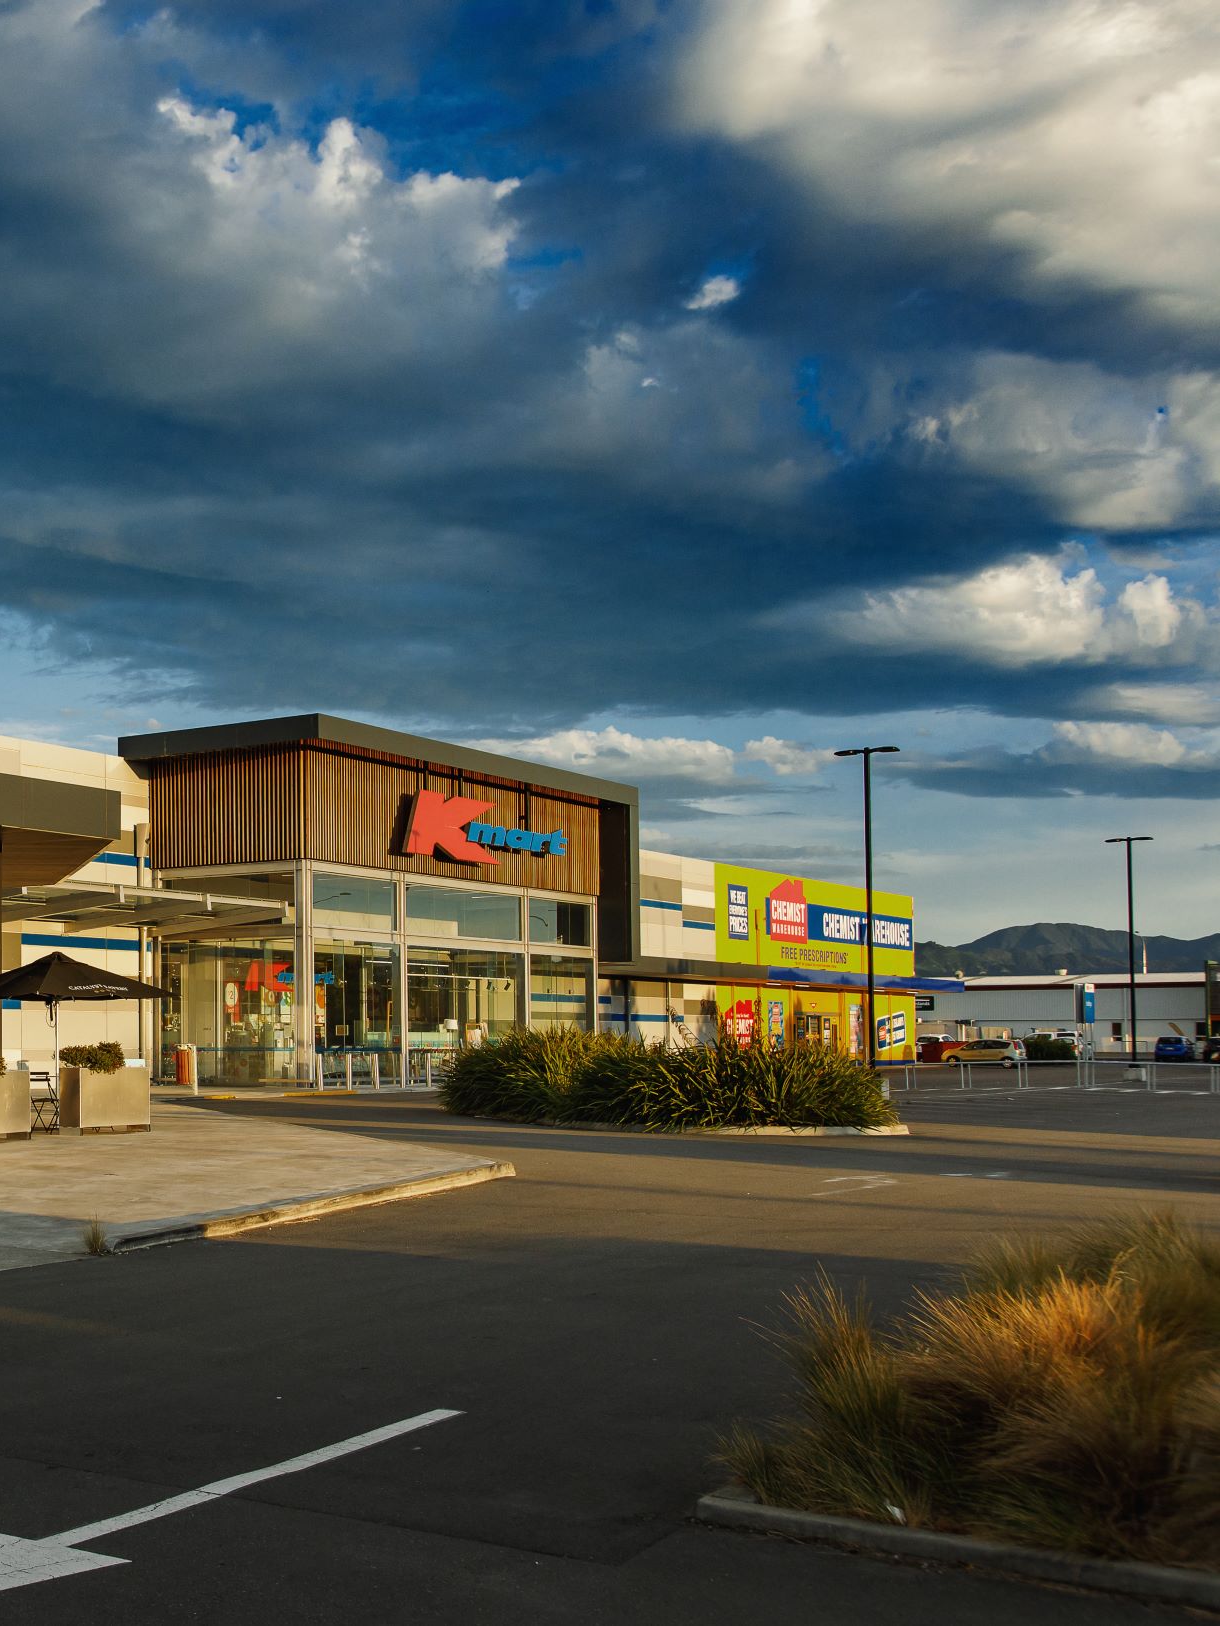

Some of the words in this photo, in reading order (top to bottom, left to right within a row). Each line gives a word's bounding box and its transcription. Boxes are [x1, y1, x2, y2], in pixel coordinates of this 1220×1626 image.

[404, 789, 569, 866] Kmart
[729, 890, 736, 904] WE
[771, 899, 806, 924] CHEMIST
[729, 915, 748, 934] PRICES
[771, 922, 806, 937] WAREHOUSE
[822, 912, 860, 941] CHEMIST
[862, 917, 911, 947] REHOUSE
[781, 946, 798, 960] FREE
[244, 959, 336, 993] Kmrt
